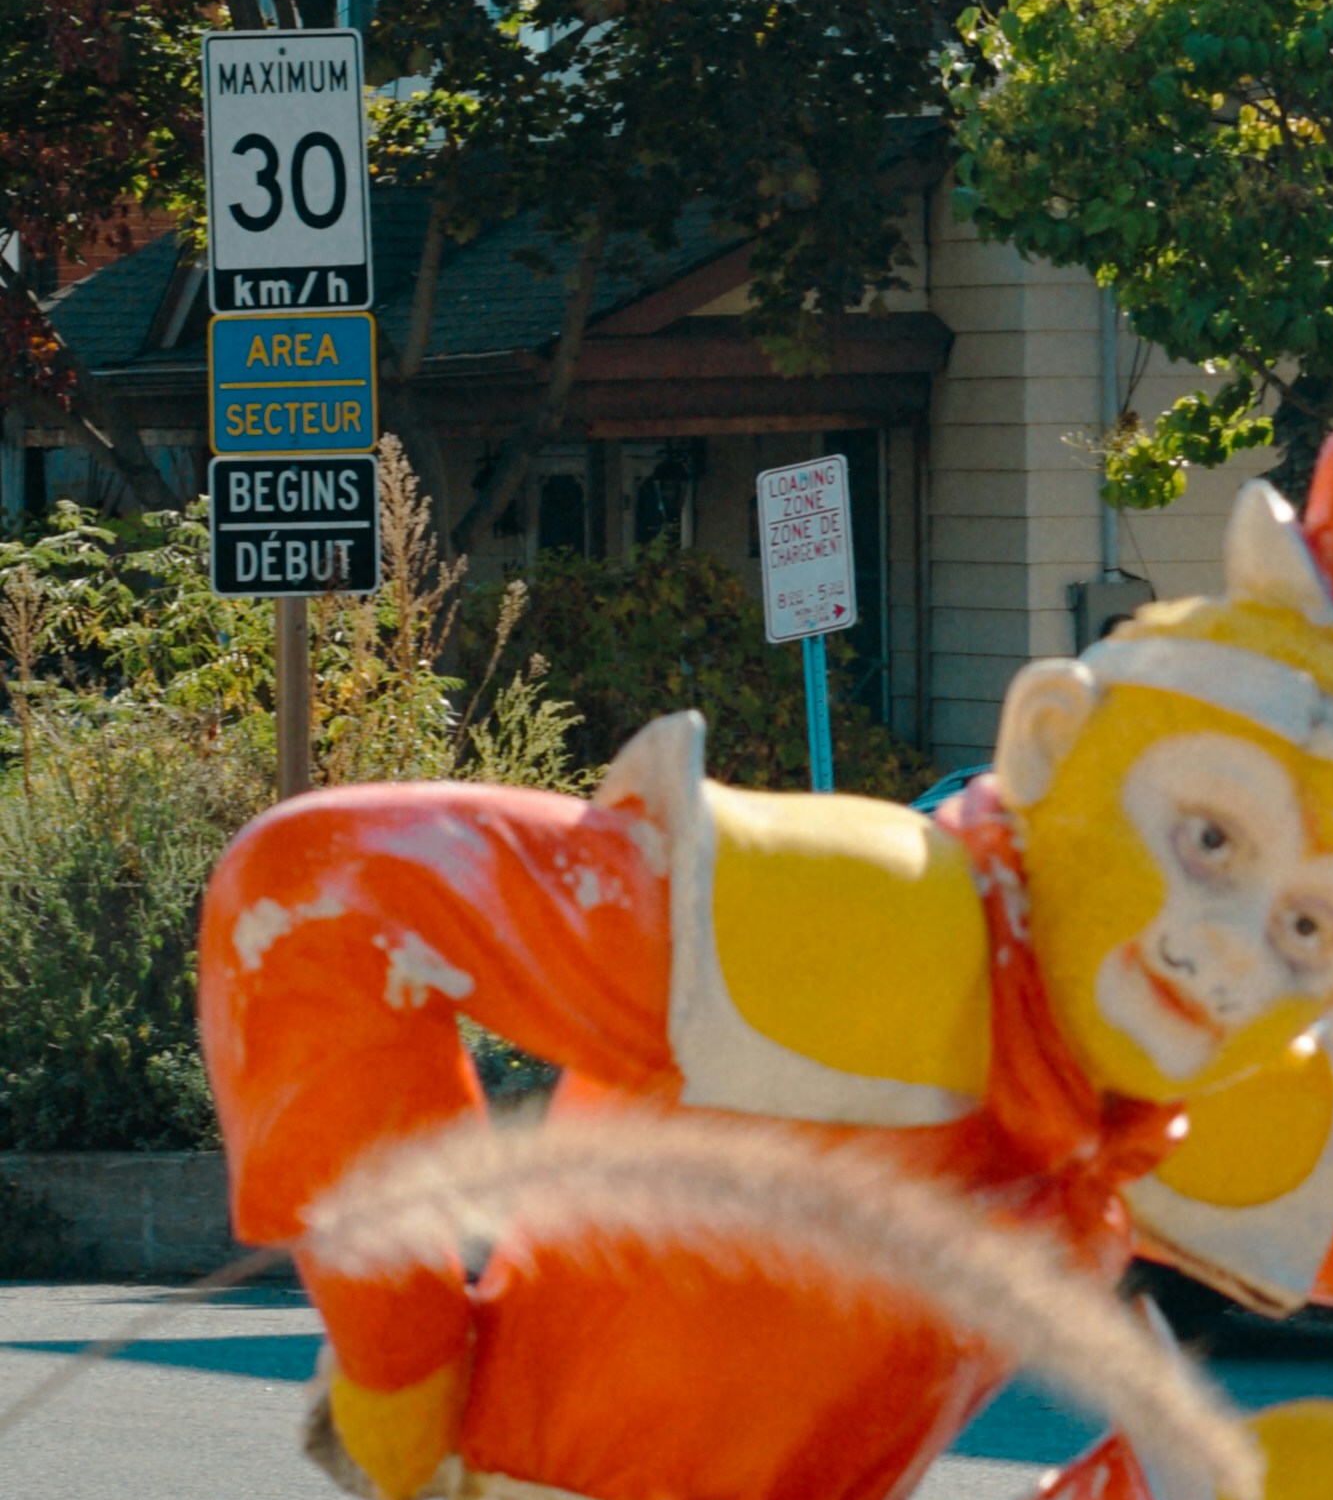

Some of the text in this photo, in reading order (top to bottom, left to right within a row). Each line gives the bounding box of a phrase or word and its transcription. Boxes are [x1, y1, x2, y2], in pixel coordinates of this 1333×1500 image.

[218, 60, 348, 95] MAXIMUM
[228, 131, 347, 232] 30
[233, 271, 349, 306] km/h
[246, 333, 339, 367] AREA
[226, 401, 361, 436] SECTEUR
[229, 469, 360, 512] BEGINS
[769, 465, 836, 498] LOADING
[783, 490, 825, 517] ZONE
[771, 513, 841, 546] ZONE DE
[236, 531, 354, 582] DÉBUT
[770, 535, 843, 568] CHARGEMENT
[817, 584, 826, 601] 5
